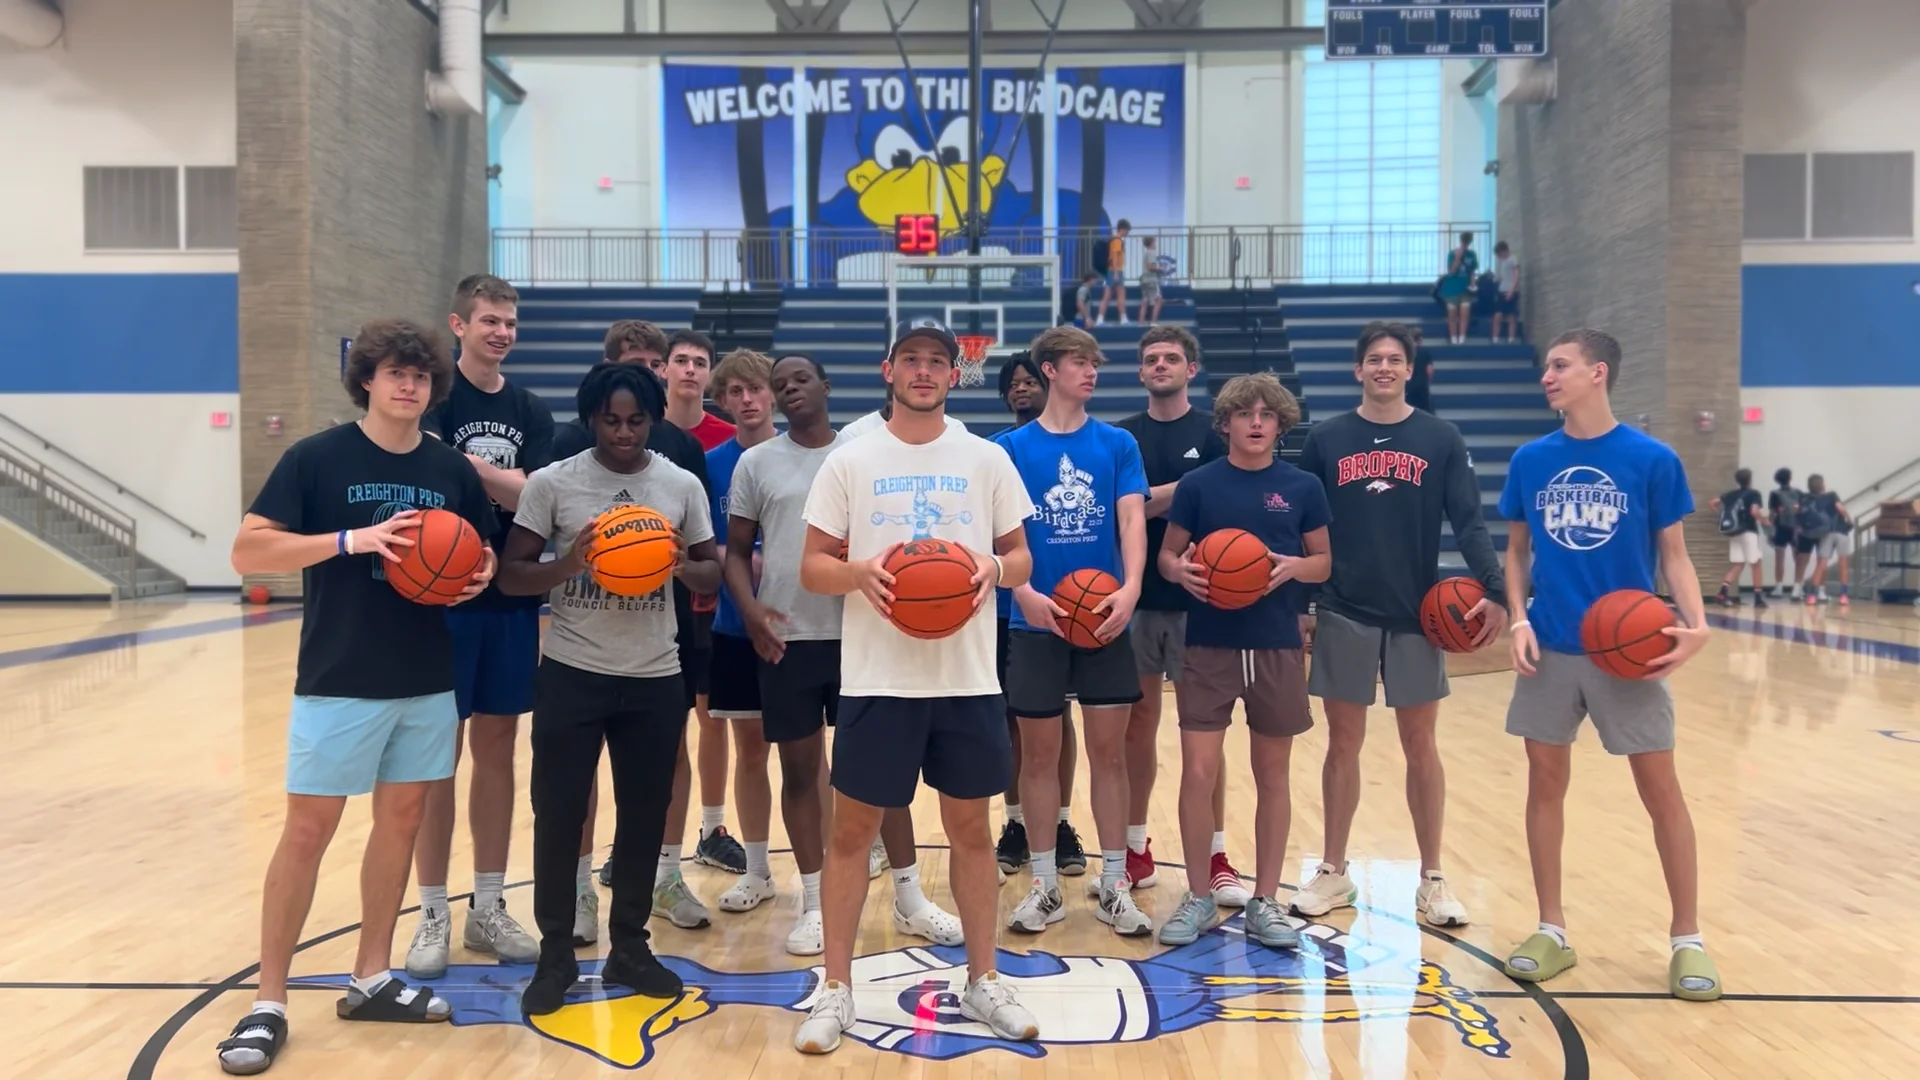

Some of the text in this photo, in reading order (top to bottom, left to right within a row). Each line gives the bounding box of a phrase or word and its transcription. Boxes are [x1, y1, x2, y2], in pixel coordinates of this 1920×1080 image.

[1333, 10, 1363, 20] FOULS
[1400, 9, 1436, 19] PLAYER
[1450, 9, 1480, 19] FOULS
[1509, 8, 1539, 18] FOULS
[1375, 45, 1393, 55] TOL
[1425, 44, 1450, 53] GAME
[1478, 44, 1497, 53] TOL
[685, 78, 851, 126] WELCOME
[861, 77, 905, 111] TO
[900, 216, 936, 249] 35
[452, 421, 507, 448] REIGHTON
[1338, 451, 1428, 487] BROPHY
[347, 483, 446, 509] CREIGHTON PREP
[873, 475, 968, 496] CREIGHTON PREP
[1536, 490, 1629, 514] BASKETBALL
[1032, 497, 1106, 529] Birdcage
[1544, 502, 1619, 532] CAMP
[603, 518, 666, 540] Wilson
[561, 597, 666, 612] COUNCIL BLUFFS
